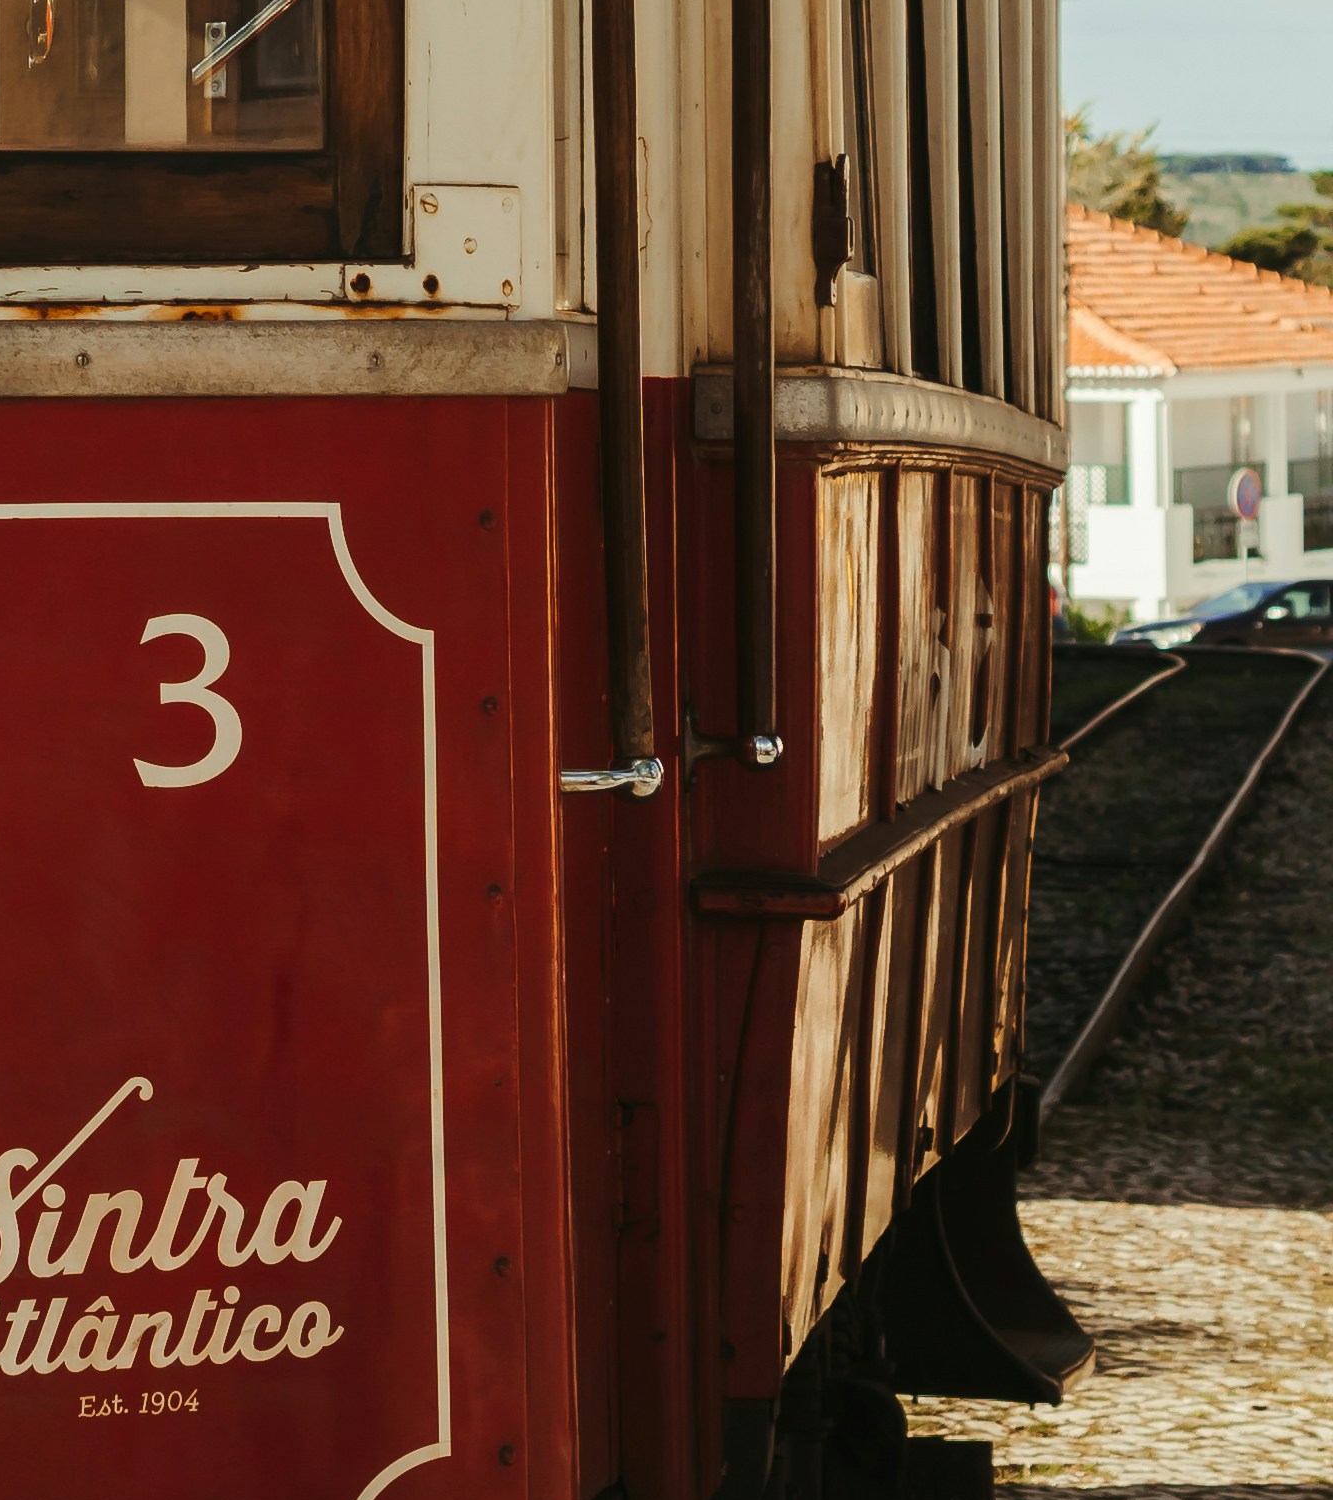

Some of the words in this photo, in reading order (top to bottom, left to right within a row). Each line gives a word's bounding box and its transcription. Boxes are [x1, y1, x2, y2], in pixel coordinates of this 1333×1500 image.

[132, 613, 244, 789] 3
[77, 1393, 130, 1418] Est.
[138, 1388, 200, 1416] 1904
